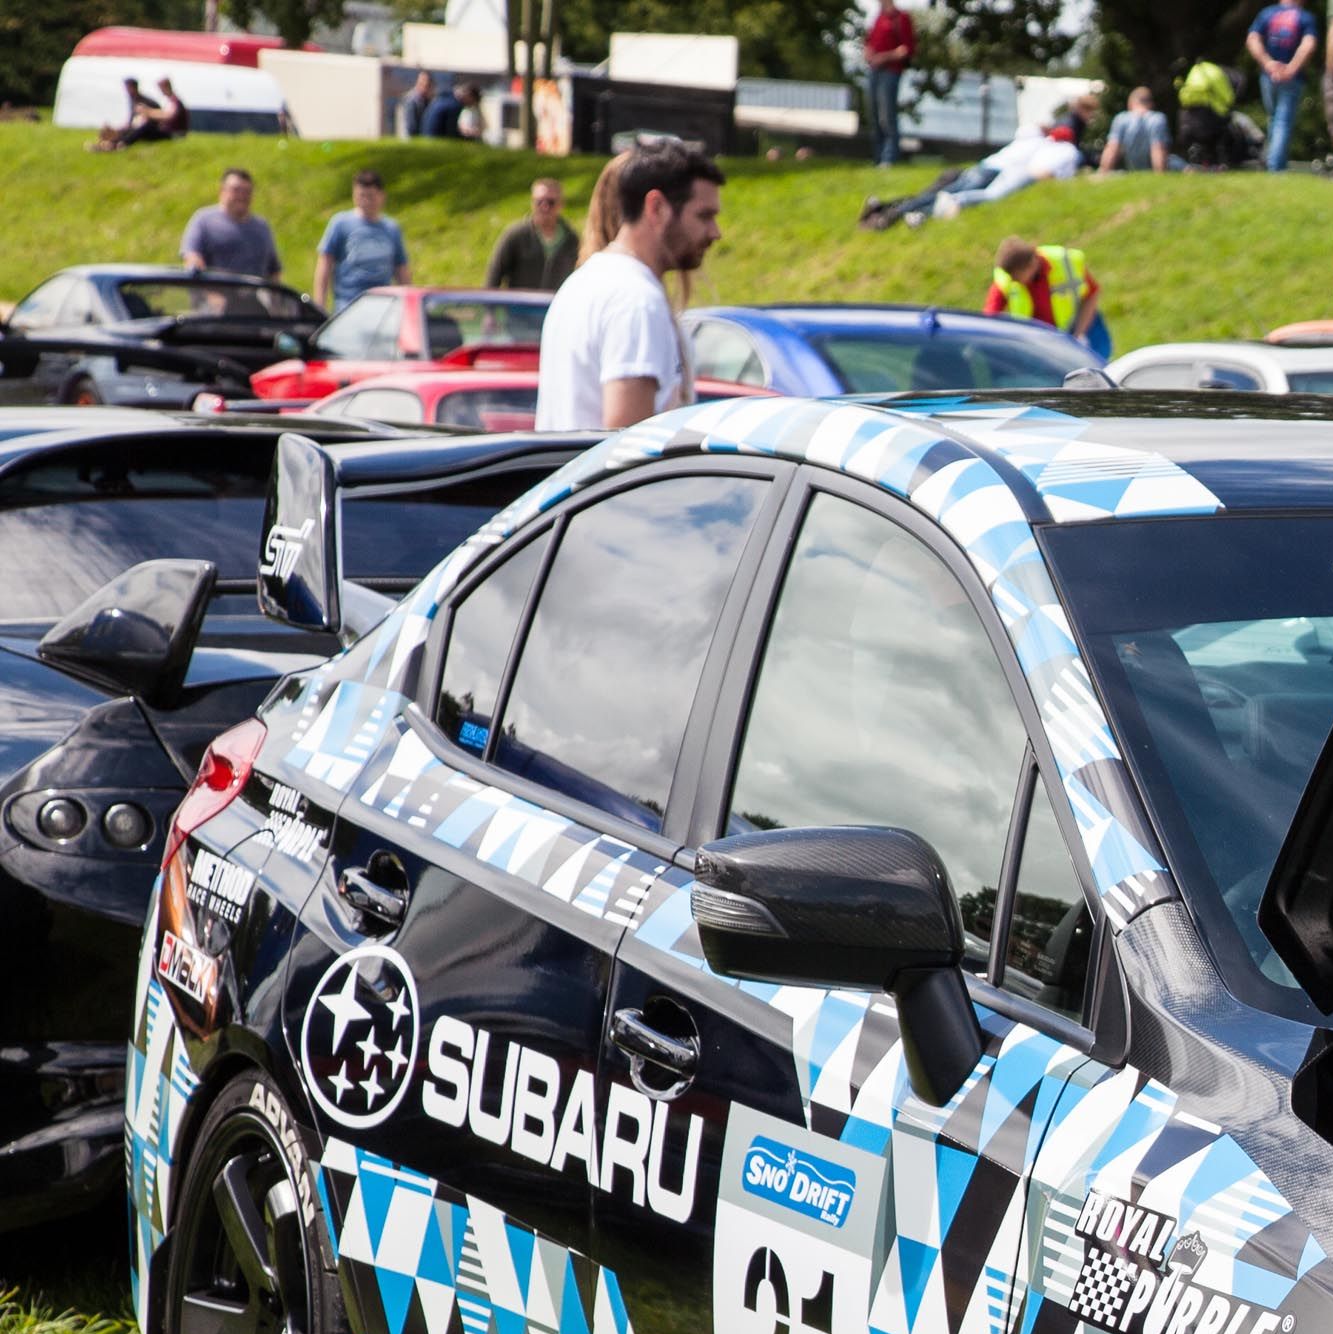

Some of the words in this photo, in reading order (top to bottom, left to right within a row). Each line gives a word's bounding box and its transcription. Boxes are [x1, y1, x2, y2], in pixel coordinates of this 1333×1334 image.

[208, 893, 242, 924] WHEELS
[422, 1014, 704, 1224] SUBARU
[789, 1174, 851, 1218] DRIFT
[1076, 1193, 1176, 1262] ROYAL
